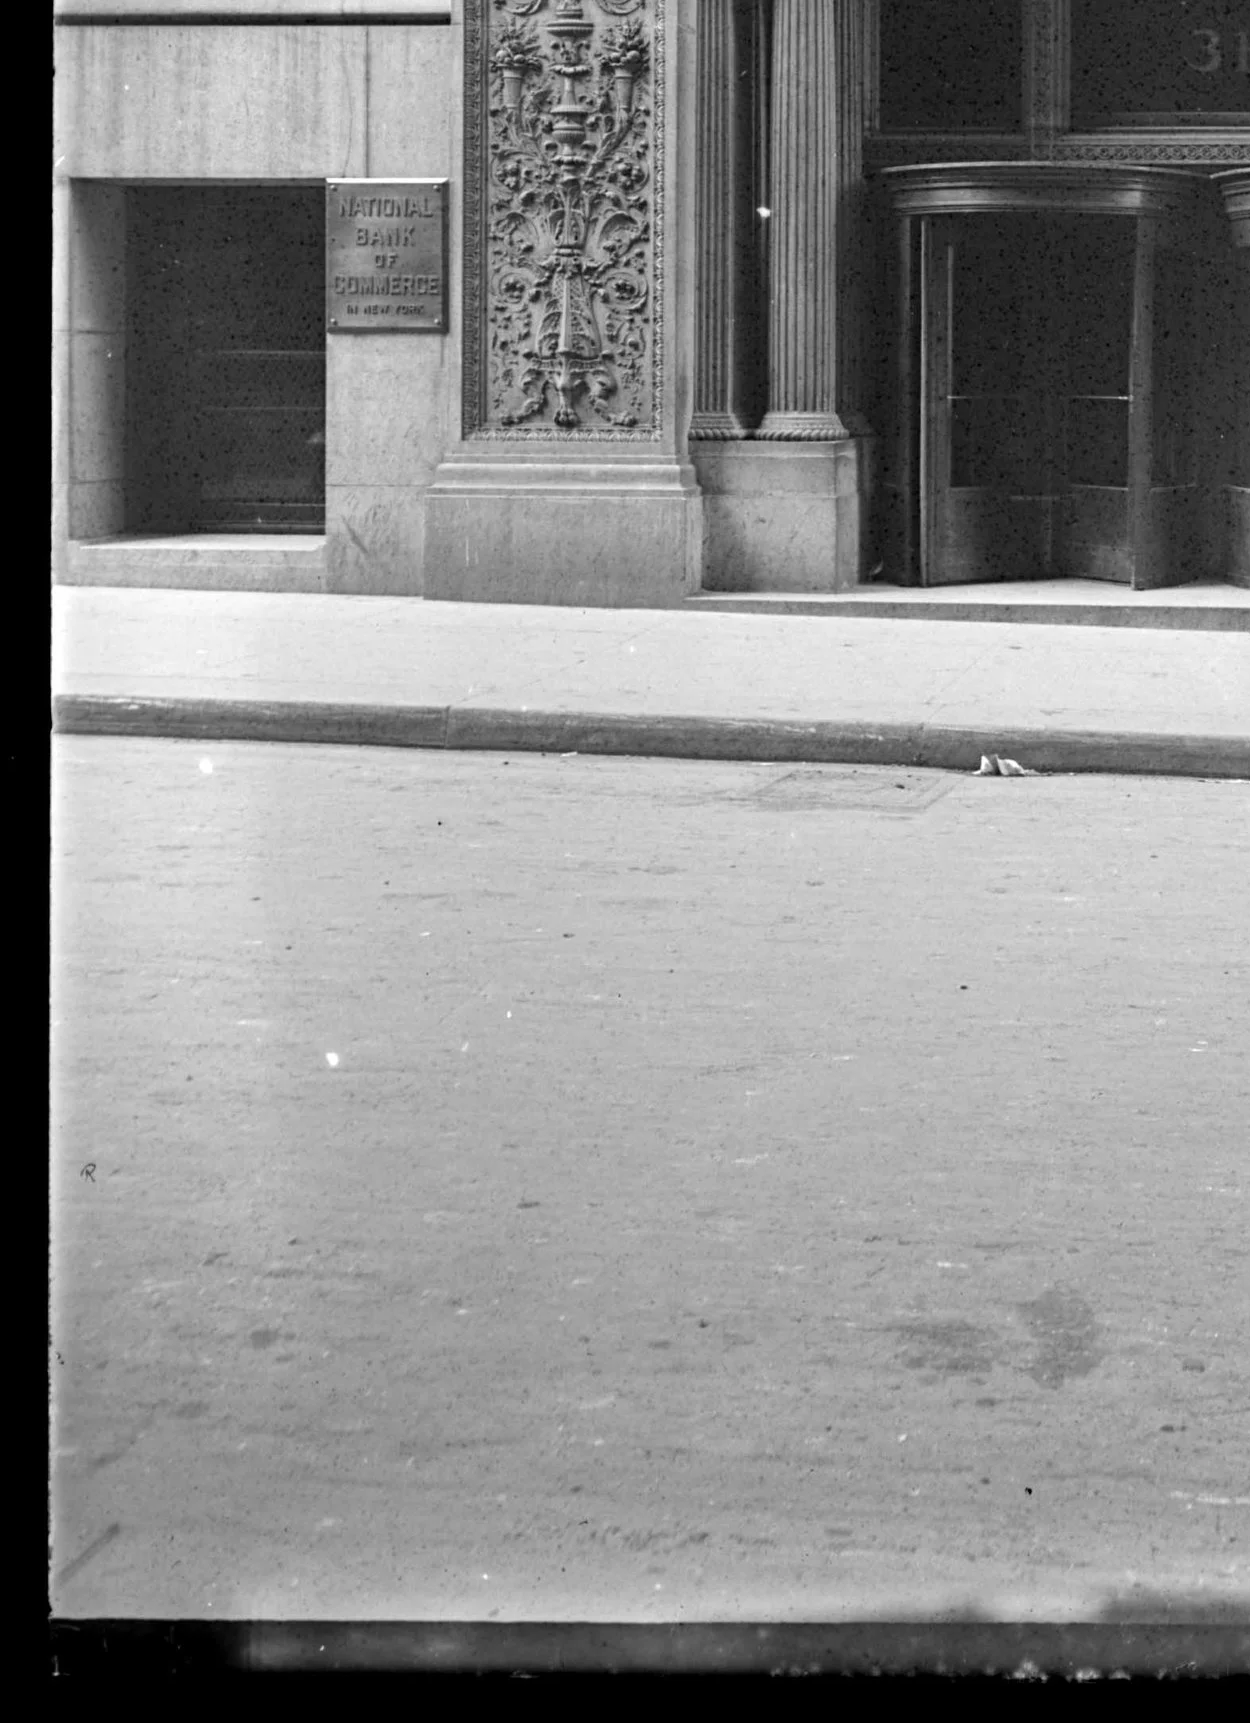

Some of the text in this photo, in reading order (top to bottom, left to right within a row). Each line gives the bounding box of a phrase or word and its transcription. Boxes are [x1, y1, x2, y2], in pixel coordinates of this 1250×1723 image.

[1183, 29, 1250, 72] 31
[339, 197, 434, 218] NATIONAL
[356, 227, 416, 247] BANK
[375, 254, 399, 268] OF
[334, 276, 440, 296] COMMERCE
[347, 304, 424, 315] IN NEW YORK
